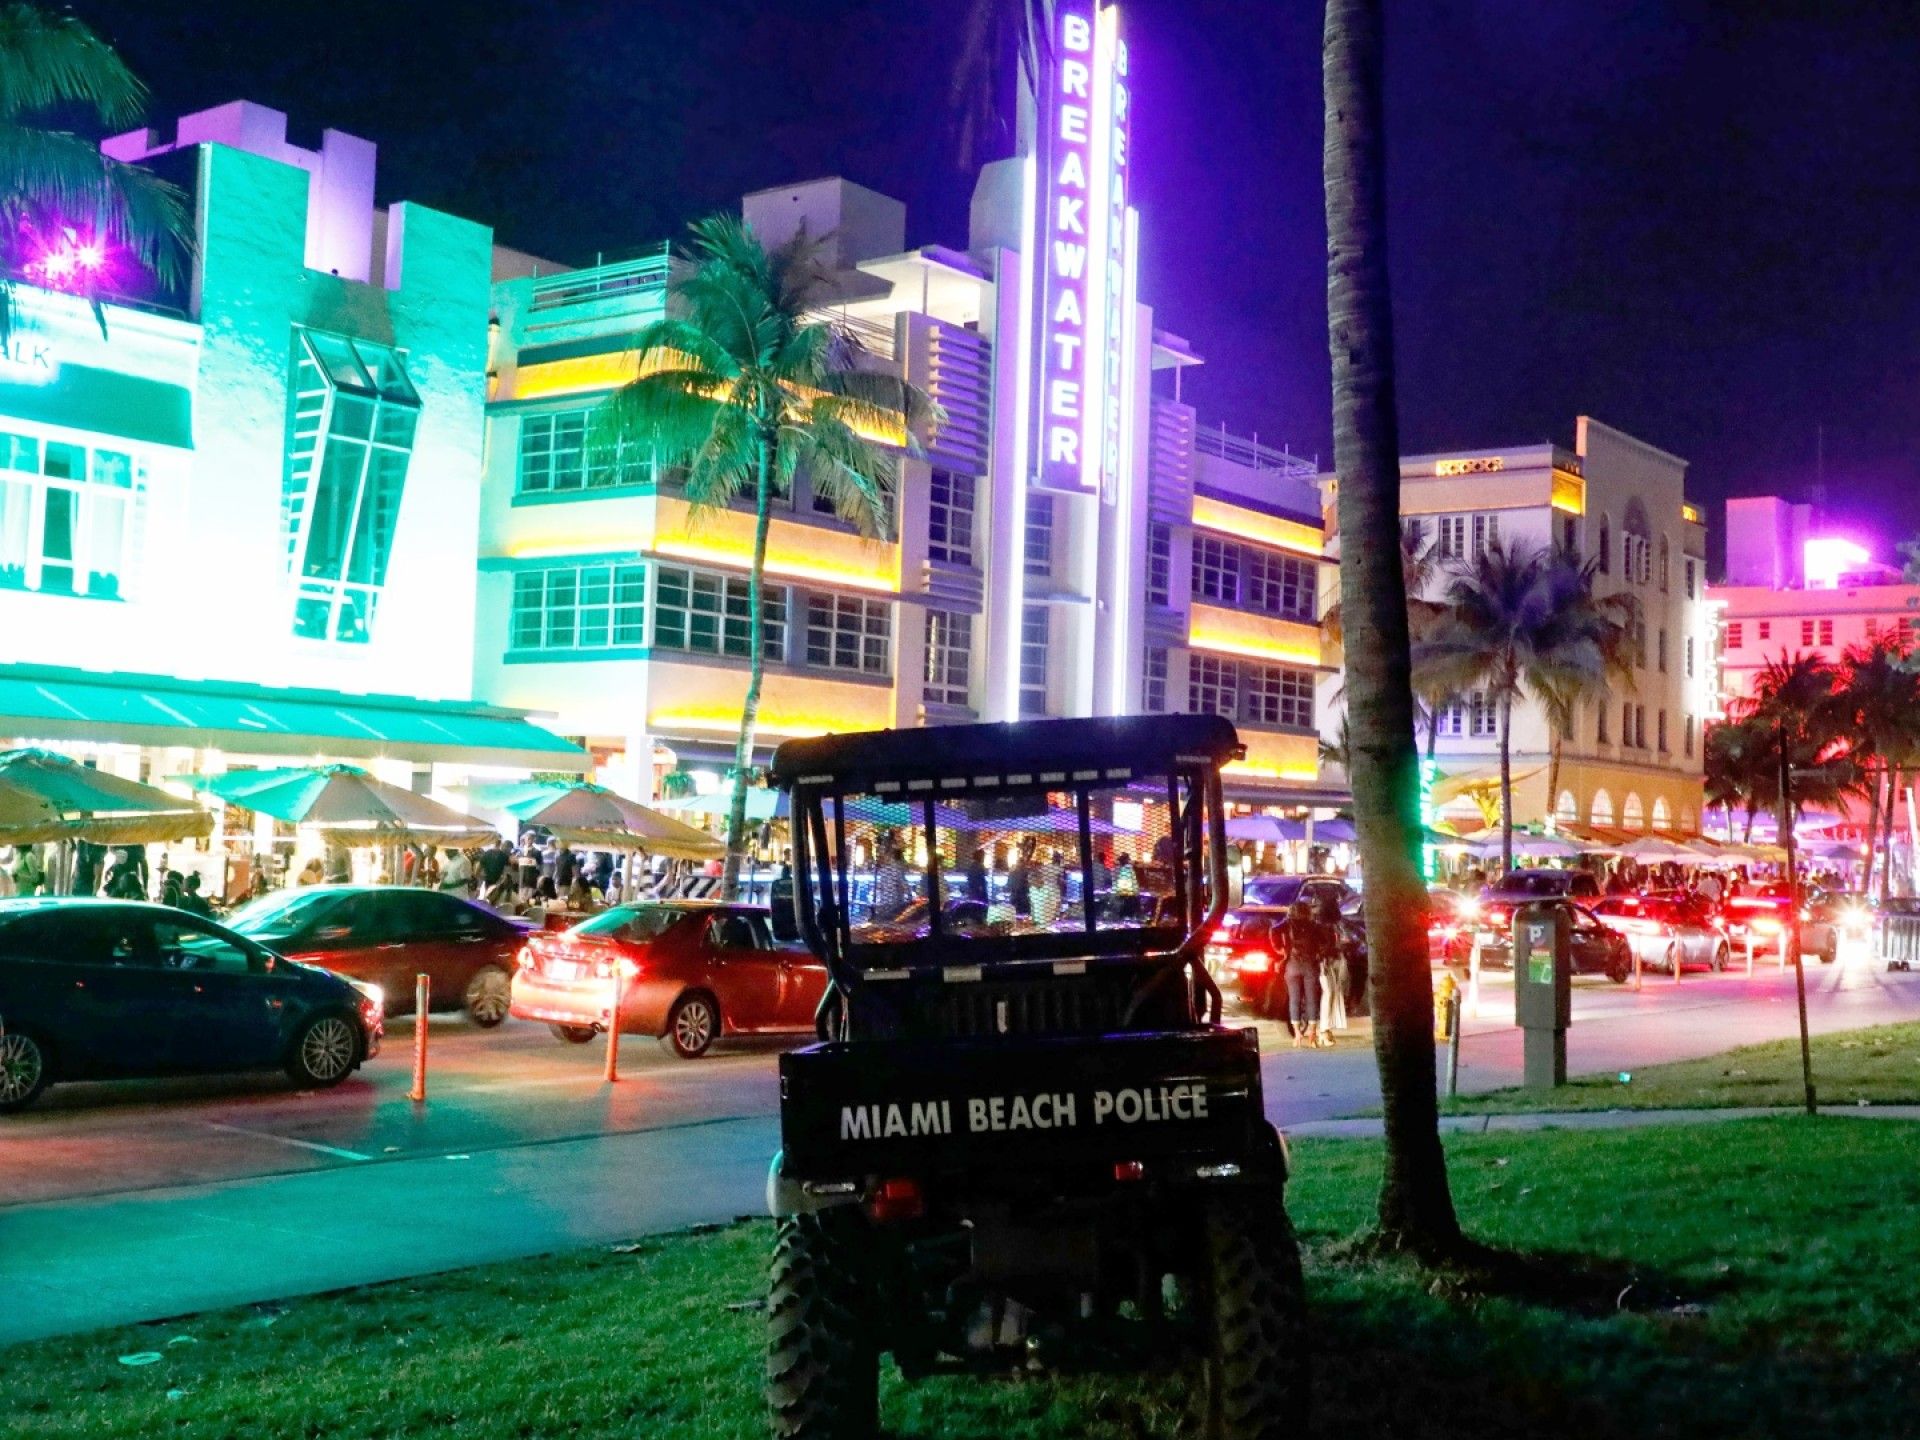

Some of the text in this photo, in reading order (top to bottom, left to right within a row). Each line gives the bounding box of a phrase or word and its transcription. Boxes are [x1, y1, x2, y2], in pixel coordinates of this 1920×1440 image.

[1050, 14, 1090, 465] BREAKWATER
[841, 1084, 1209, 1140] MIAMI BEACH POLICE
